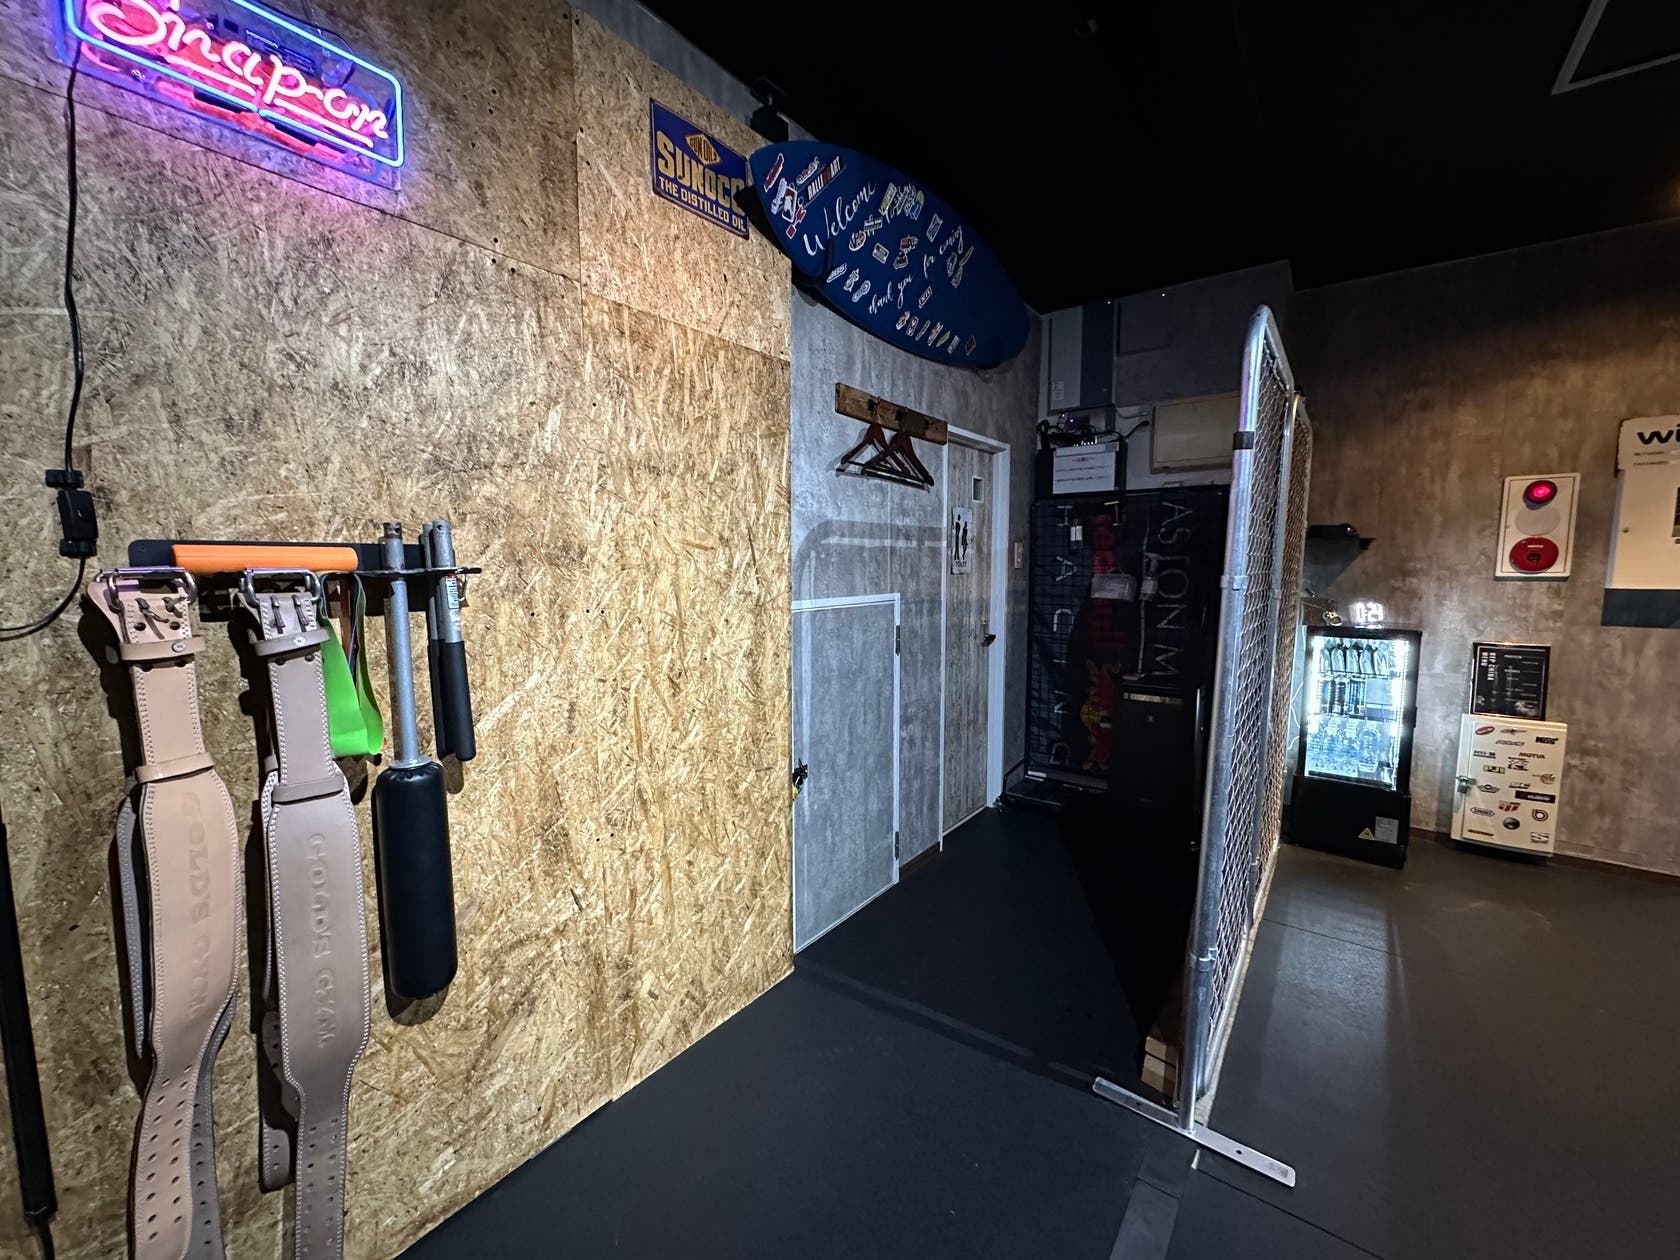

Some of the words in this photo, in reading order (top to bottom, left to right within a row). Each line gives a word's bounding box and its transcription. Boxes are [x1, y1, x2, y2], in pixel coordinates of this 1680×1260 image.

[659, 176, 679, 198] THE
[680, 188, 730, 223] DISTILLED
[732, 213, 746, 233] OIL
